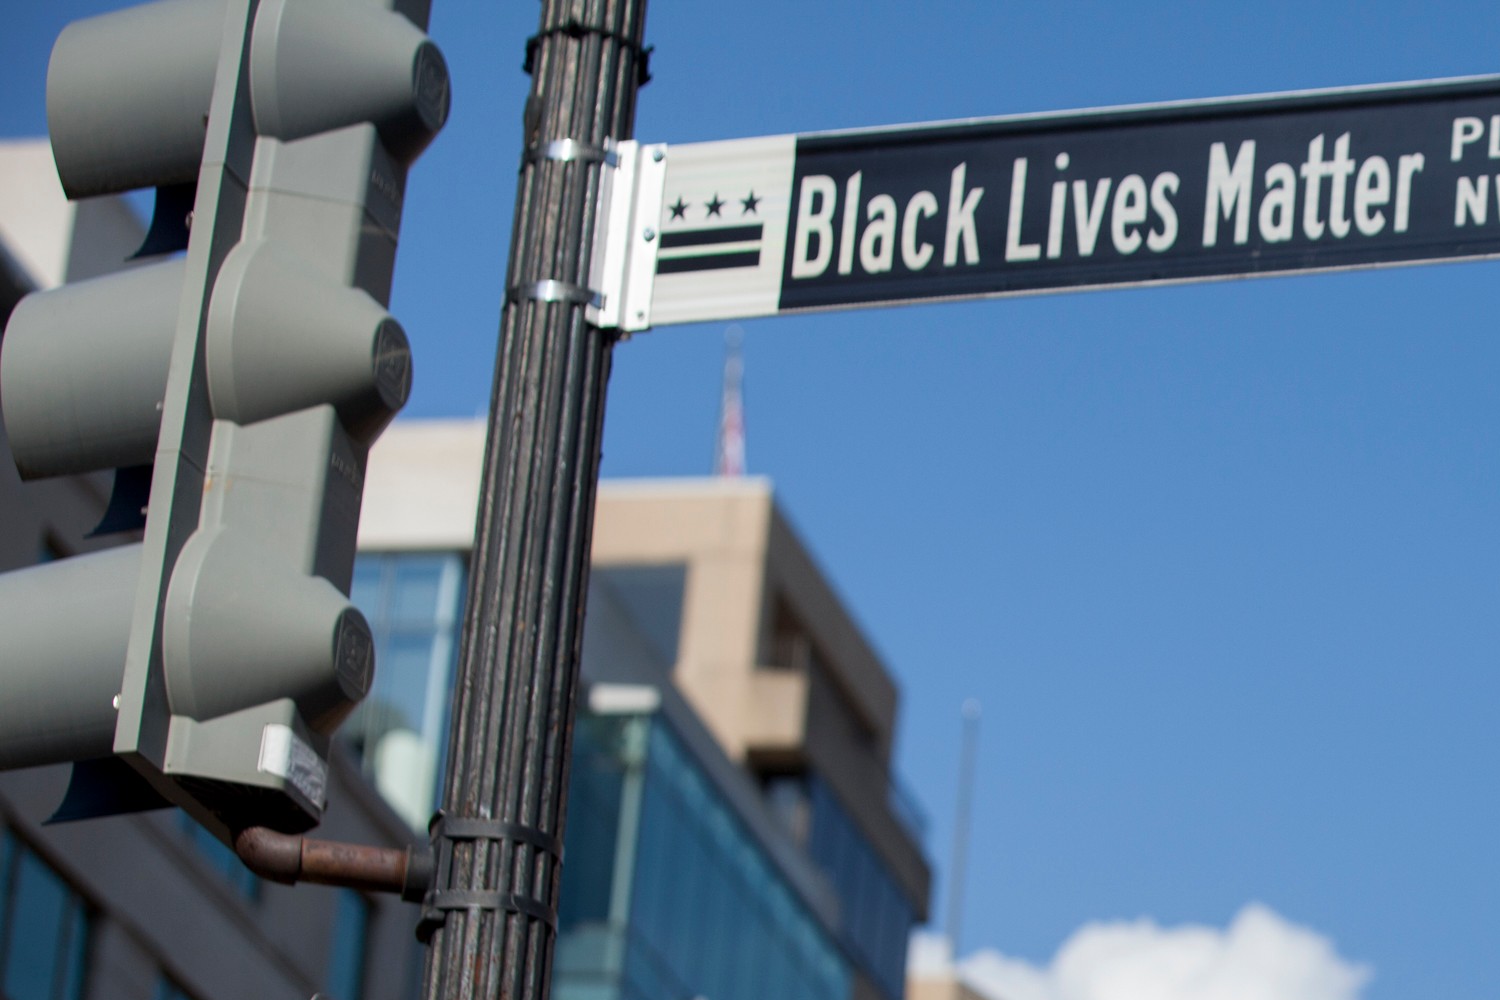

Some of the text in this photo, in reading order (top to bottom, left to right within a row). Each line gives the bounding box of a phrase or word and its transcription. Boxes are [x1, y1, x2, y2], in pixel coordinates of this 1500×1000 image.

[791, 131, 1425, 279] Black Lives Matter
